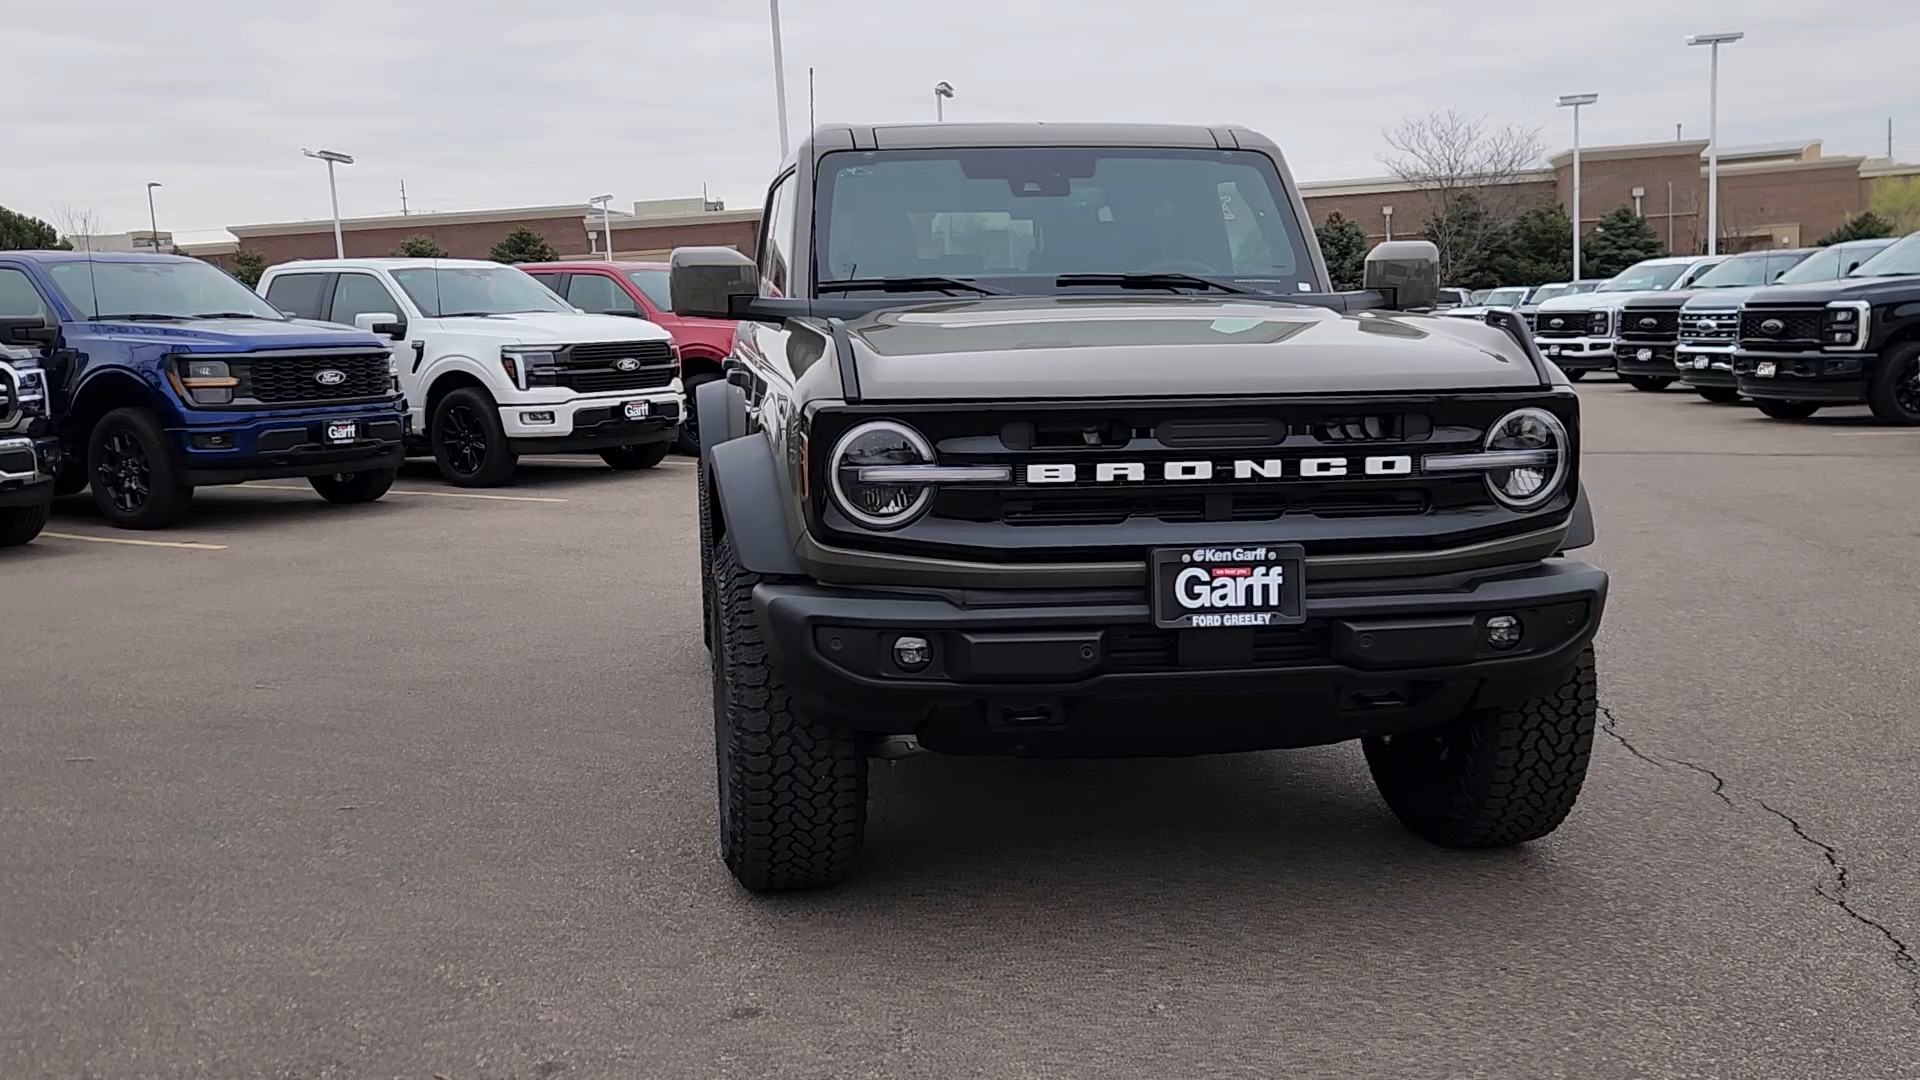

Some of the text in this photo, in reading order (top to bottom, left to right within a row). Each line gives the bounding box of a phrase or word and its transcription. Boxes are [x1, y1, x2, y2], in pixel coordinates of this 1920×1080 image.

[624, 403, 649, 417] Garff
[328, 424, 356, 438] Garff
[1027, 455, 1412, 483] BRONCO
[1206, 548, 1266, 562] Ken Garff
[1174, 566, 1283, 609] Garff
[1192, 613, 1272, 627] FORD GREELEY
